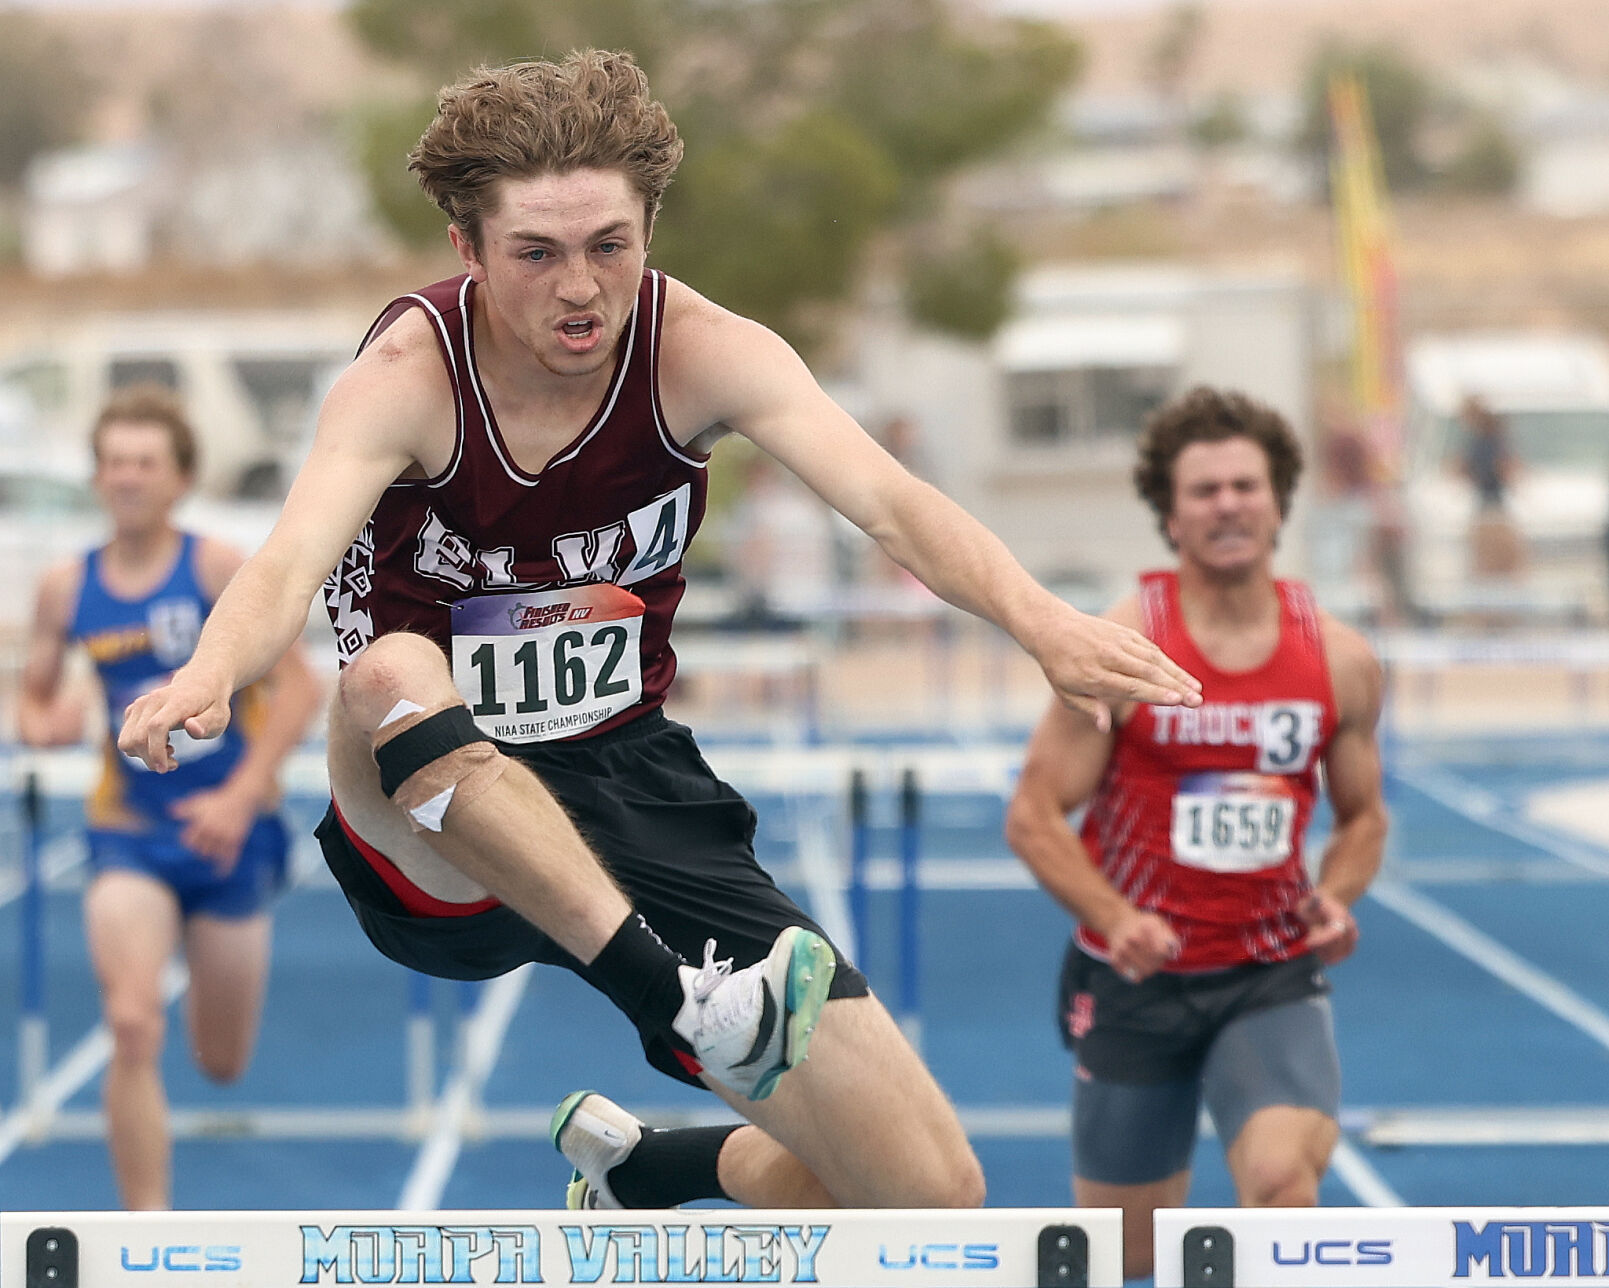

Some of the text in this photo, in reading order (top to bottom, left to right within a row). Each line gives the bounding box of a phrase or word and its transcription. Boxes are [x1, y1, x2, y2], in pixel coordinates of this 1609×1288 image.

[414, 506, 630, 591] ELK
[635, 497, 678, 571] 4
[519, 612, 567, 629] RESULTS
[572, 608, 589, 619] NV
[471, 626, 630, 716] 1162
[494, 725, 518, 737] NIAA
[520, 721, 546, 735] STATE
[547, 706, 613, 731] CHAMPIONSHIP
[1152, 703, 1323, 746] TRUC
[1267, 708, 1301, 766] 3
[1188, 802, 1283, 848] 1659
[121, 1245, 243, 1272] UCS
[298, 1225, 832, 1284] MOAPA VALLEY
[879, 1244, 999, 1270] UCS
[1273, 1240, 1395, 1265] UCS
[1452, 1219, 1609, 1278] MOA
